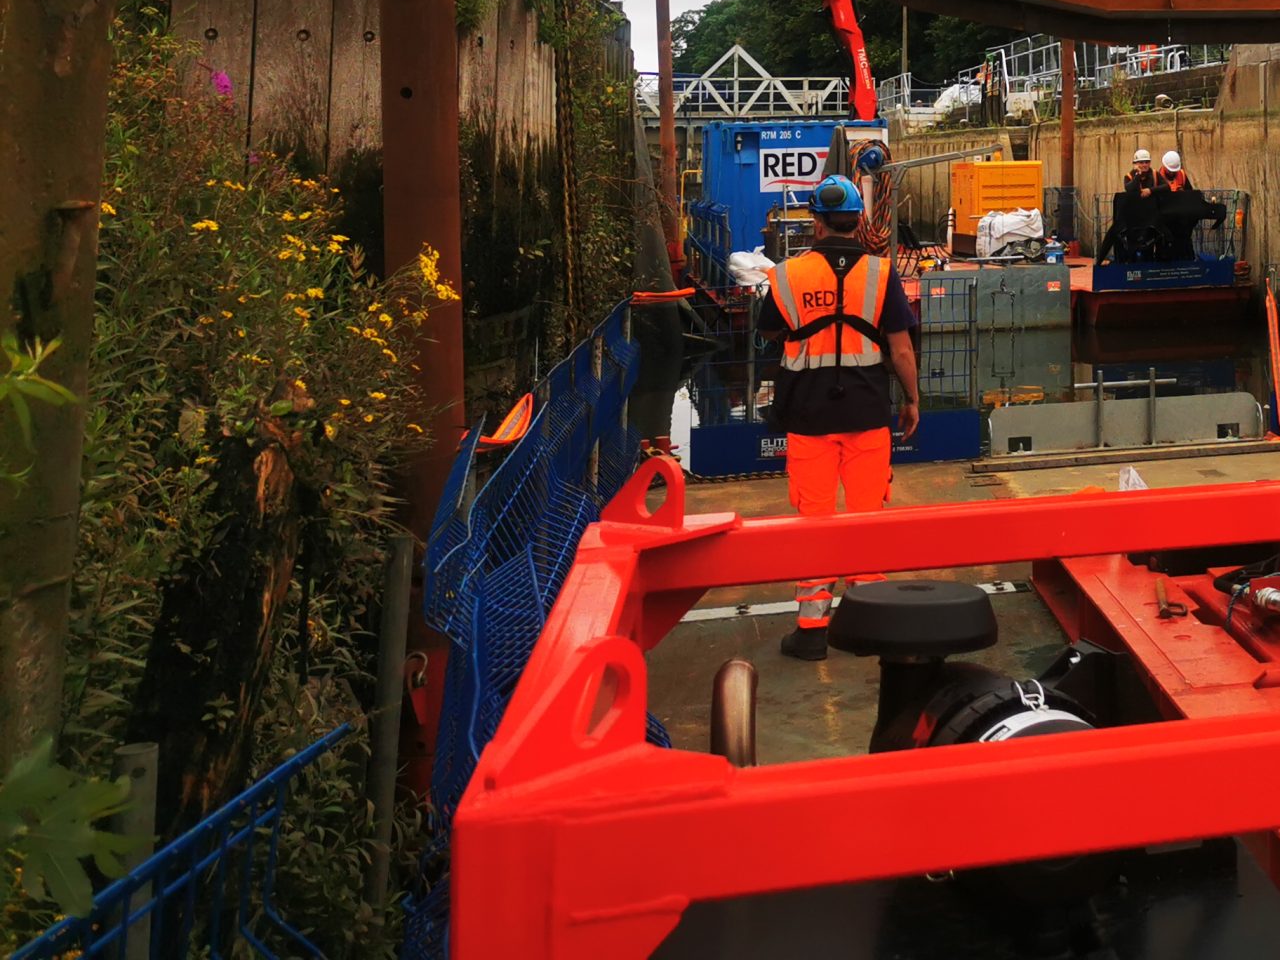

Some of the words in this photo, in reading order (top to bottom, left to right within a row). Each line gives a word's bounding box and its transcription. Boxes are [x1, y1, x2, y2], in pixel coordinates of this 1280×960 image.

[857, 47, 868, 69] TMC
[761, 131, 777, 140] R7M
[779, 131, 792, 140] 205
[795, 130, 801, 139] C
[802, 290, 848, 309] RED
